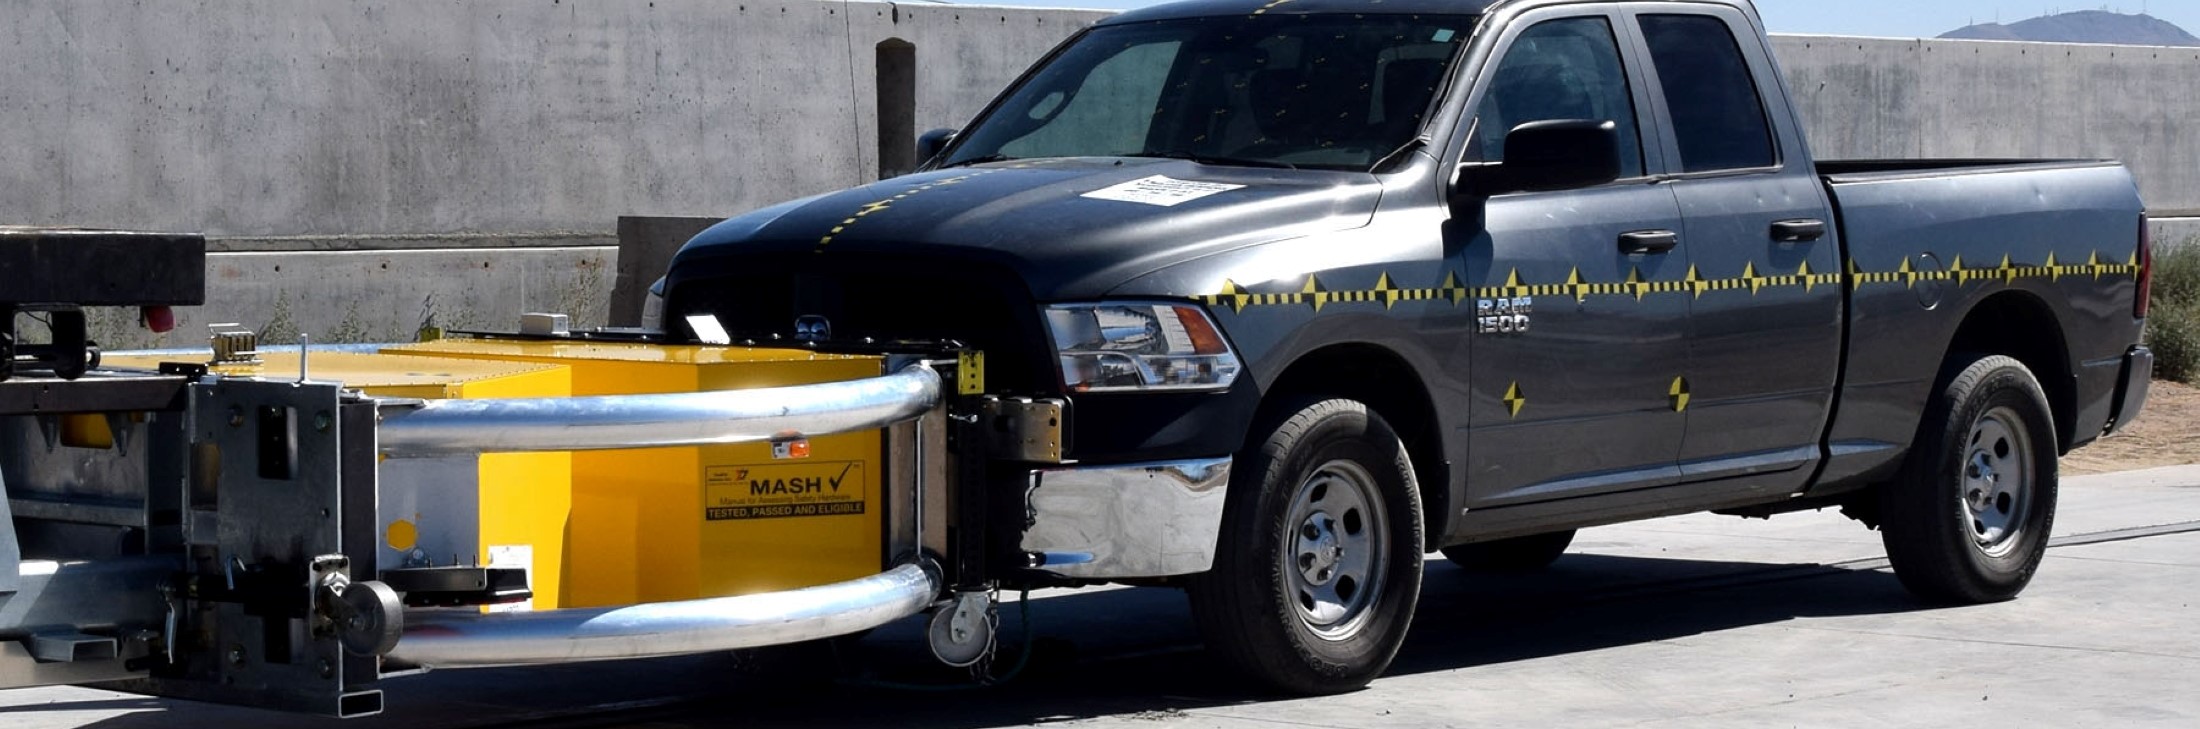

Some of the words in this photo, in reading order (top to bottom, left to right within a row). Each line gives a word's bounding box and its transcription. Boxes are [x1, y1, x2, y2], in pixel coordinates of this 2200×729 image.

[1477, 297, 1532, 315] RAM
[1478, 315, 1530, 333] 1500
[750, 477, 821, 495] MASH
[720, 497, 745, 505] Manual
[794, 494, 816, 503] Safety
[818, 493, 851, 501] Hardware
[709, 508, 750, 519] TESTED,
[752, 506, 792, 516] PASSED
[794, 505, 815, 515] AND
[818, 503, 862, 514] ELIGIBLE
